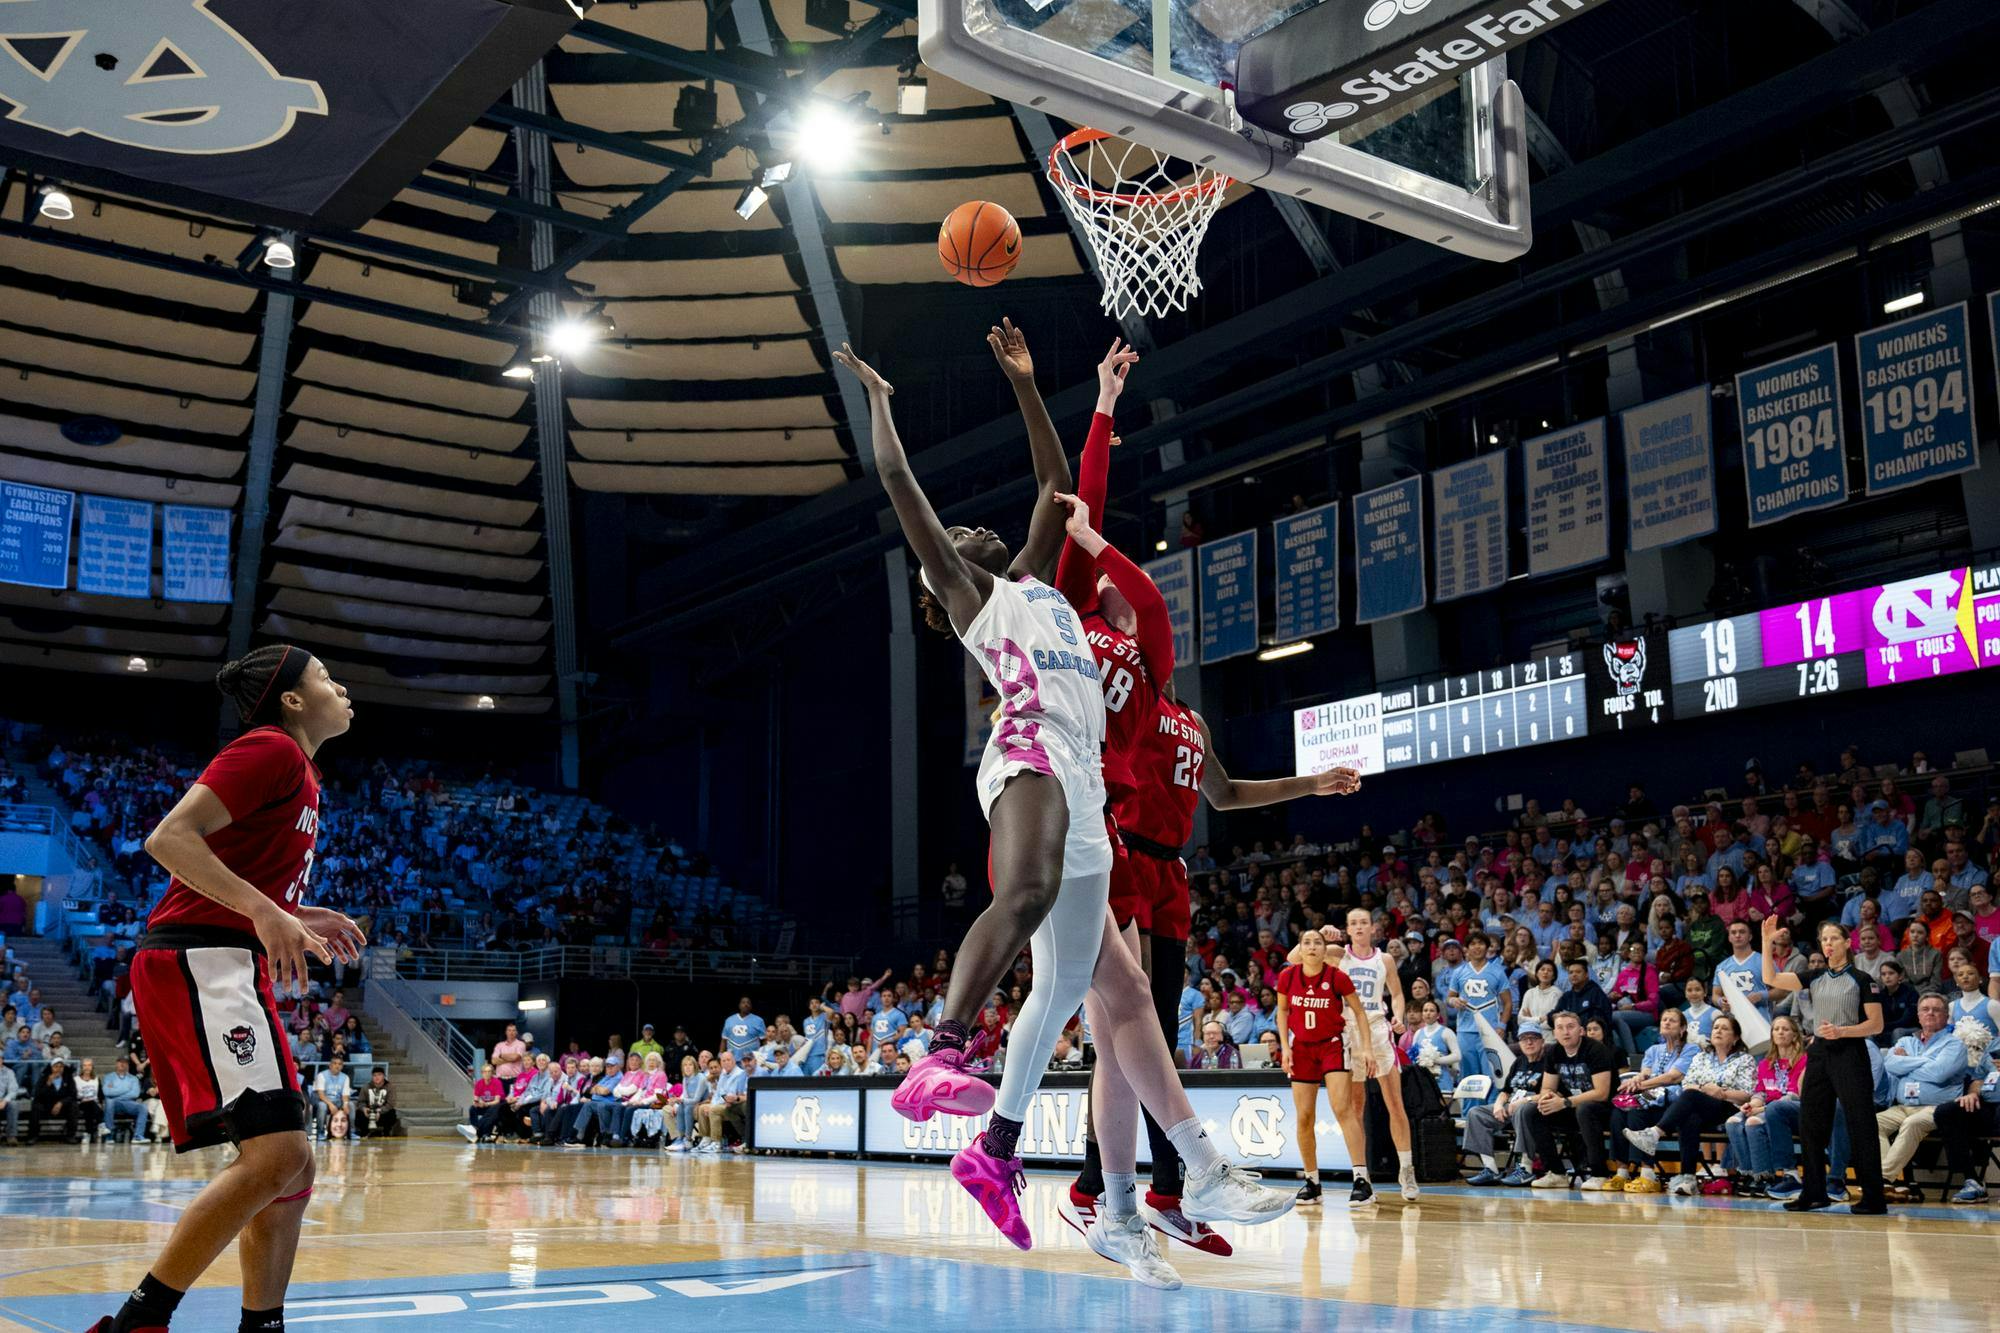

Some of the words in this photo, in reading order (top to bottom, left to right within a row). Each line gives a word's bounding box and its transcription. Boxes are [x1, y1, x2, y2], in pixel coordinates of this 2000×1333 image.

[1877, 323, 1948, 360] WOMEN'S
[1756, 363, 1820, 398] WOMEN'S
[1866, 347, 1961, 388] BASKETBALL
[1747, 386, 1832, 424] BASKETBALL
[1866, 370, 1966, 434] 1994
[1748, 408, 1836, 470] 1984
[1903, 425, 1936, 450] ACC
[1536, 443, 1594, 471] BASKETBALL
[1874, 441, 1967, 481] CHAMPIONS
[1781, 460, 1810, 483] ACC
[5, 485, 68, 506] GYMNASTICS
[10, 498, 33, 512] EAGL
[34, 501, 60, 516] TEAM
[1756, 475, 1839, 513] CHAMPIONS
[5, 509, 63, 528] CHAMPIONS
[1364, 501, 1411, 525] BASKETBALL
[1284, 527, 1328, 550] BASKETBALL
[1370, 535, 1396, 553] SWEET
[1398, 532, 1407, 544] 16
[1290, 559, 1313, 576] SWEET
[1051, 608, 1078, 645] 5
[1086, 630, 1113, 649] NC
[1700, 618, 1737, 677] 19
[1795, 597, 1836, 658] 14
[1878, 645, 1903, 665] TOL
[1915, 635, 1956, 658] FOULS
[1888, 665, 1896, 683] 4
[1932, 656, 1941, 675] 0
[1100, 657, 1134, 713] 18
[1382, 691, 1412, 712] PLAYER
[1428, 684, 1435, 703] 0
[1460, 677, 1467, 697] 3
[1524, 662, 1537, 683] 22
[1559, 655, 1573, 676] 35
[1704, 676, 1738, 712] 2ND
[1796, 658, 1839, 696] 7:26
[1318, 702, 1376, 728] Hilton
[1383, 719, 1413, 738] POINTS
[1495, 700, 1502, 718] 4
[1529, 693, 1536, 712] 2
[1565, 686, 1571, 705] 4
[1603, 694, 1635, 715] FOULS
[1643, 689, 1664, 708] TOL
[1159, 716, 1179, 735] NC
[1616, 713, 1623, 729] 1
[1651, 707, 1659, 724] 4
[1302, 727, 1350, 748] Garden
[1353, 723, 1377, 738] Inn
[1386, 745, 1412, 764] FOULS
[1497, 729, 1503, 747] 1
[1319, 743, 1359, 761] DURHAM
[1291, 995, 1303, 1007] NC
[1303, 997, 1331, 1009] STATE
[1352, 980, 1375, 998] 20
[1304, 1010, 1316, 1030] 0
